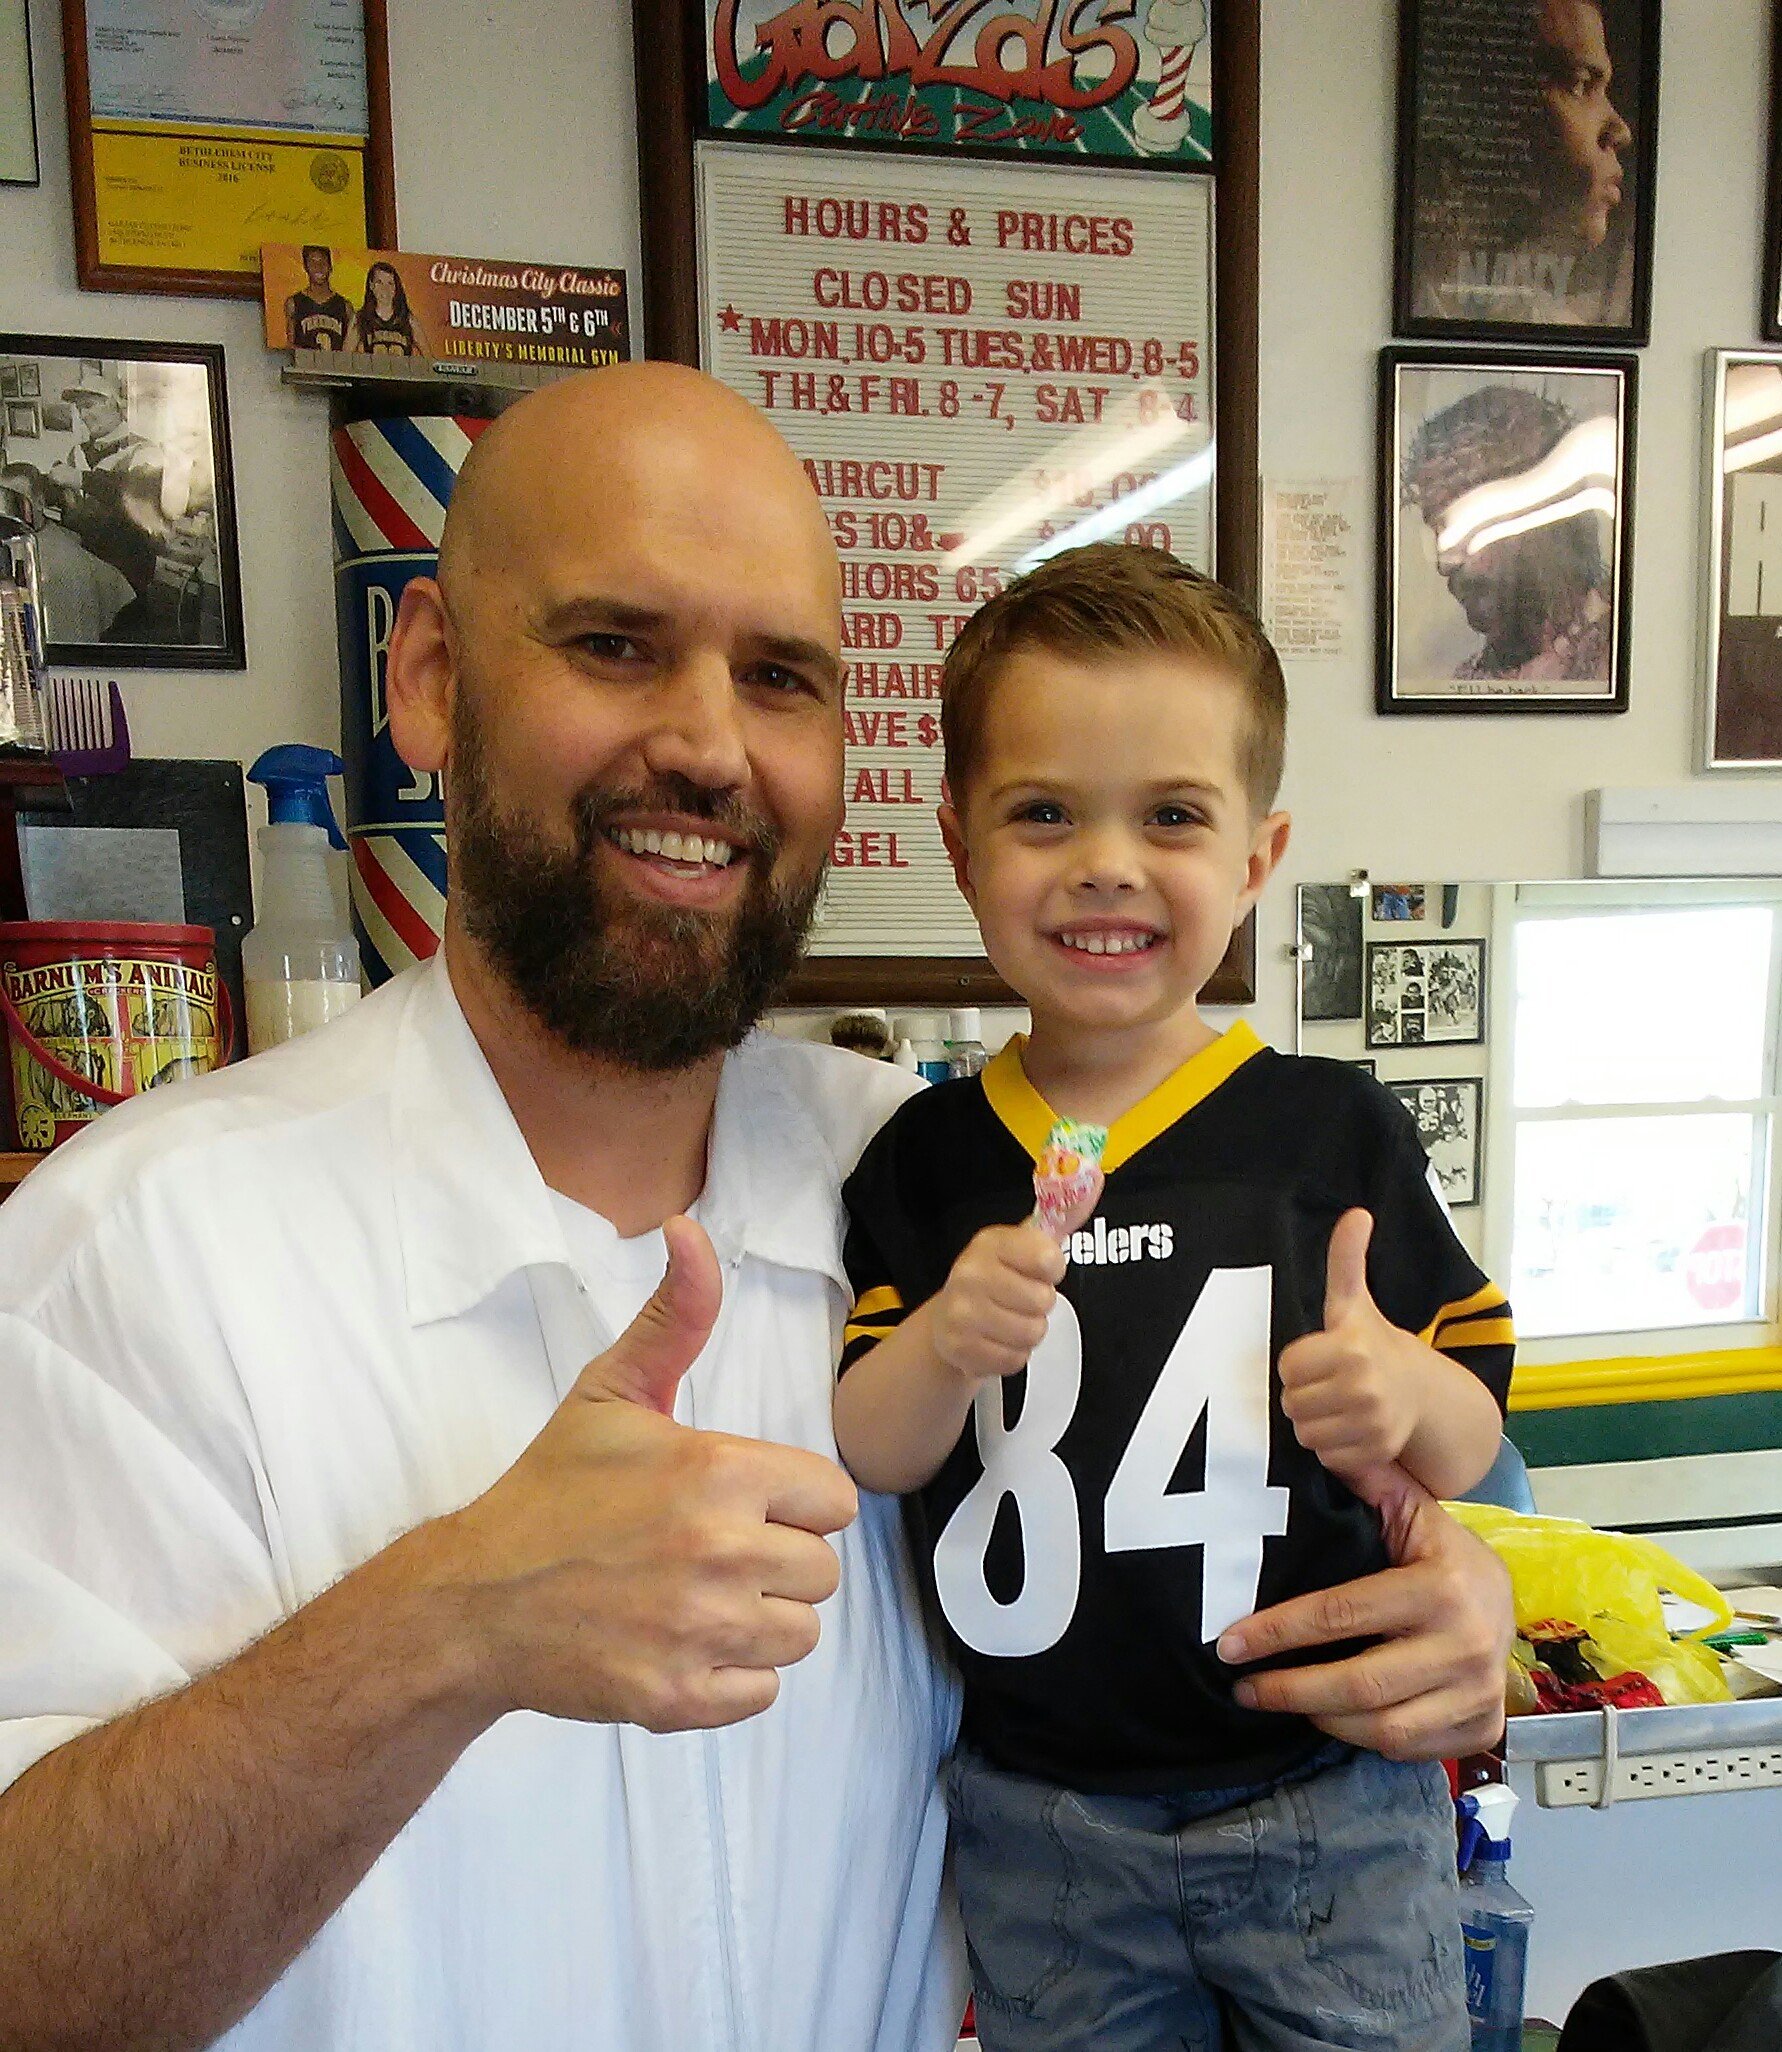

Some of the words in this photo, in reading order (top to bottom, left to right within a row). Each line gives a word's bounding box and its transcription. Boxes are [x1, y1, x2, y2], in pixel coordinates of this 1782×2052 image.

[785, 197, 930, 245] HOURS
[947, 208, 971, 246] &
[997, 210, 1134, 257] PRICES
[430, 262, 518, 290] Christmas
[521, 268, 558, 298] City
[558, 273, 621, 297] Classic
[813, 267, 973, 316] CLOSED
[1007, 278, 1082, 321] SUN
[449, 300, 540, 333] DECEMBER
[518, 343, 587, 364] MEMORIAL
[590, 348, 619, 367] GYM
[853, 766, 925, 805] ALL
[831, 831, 909, 867] GEL
[934, 1264, 1291, 1658] 84
